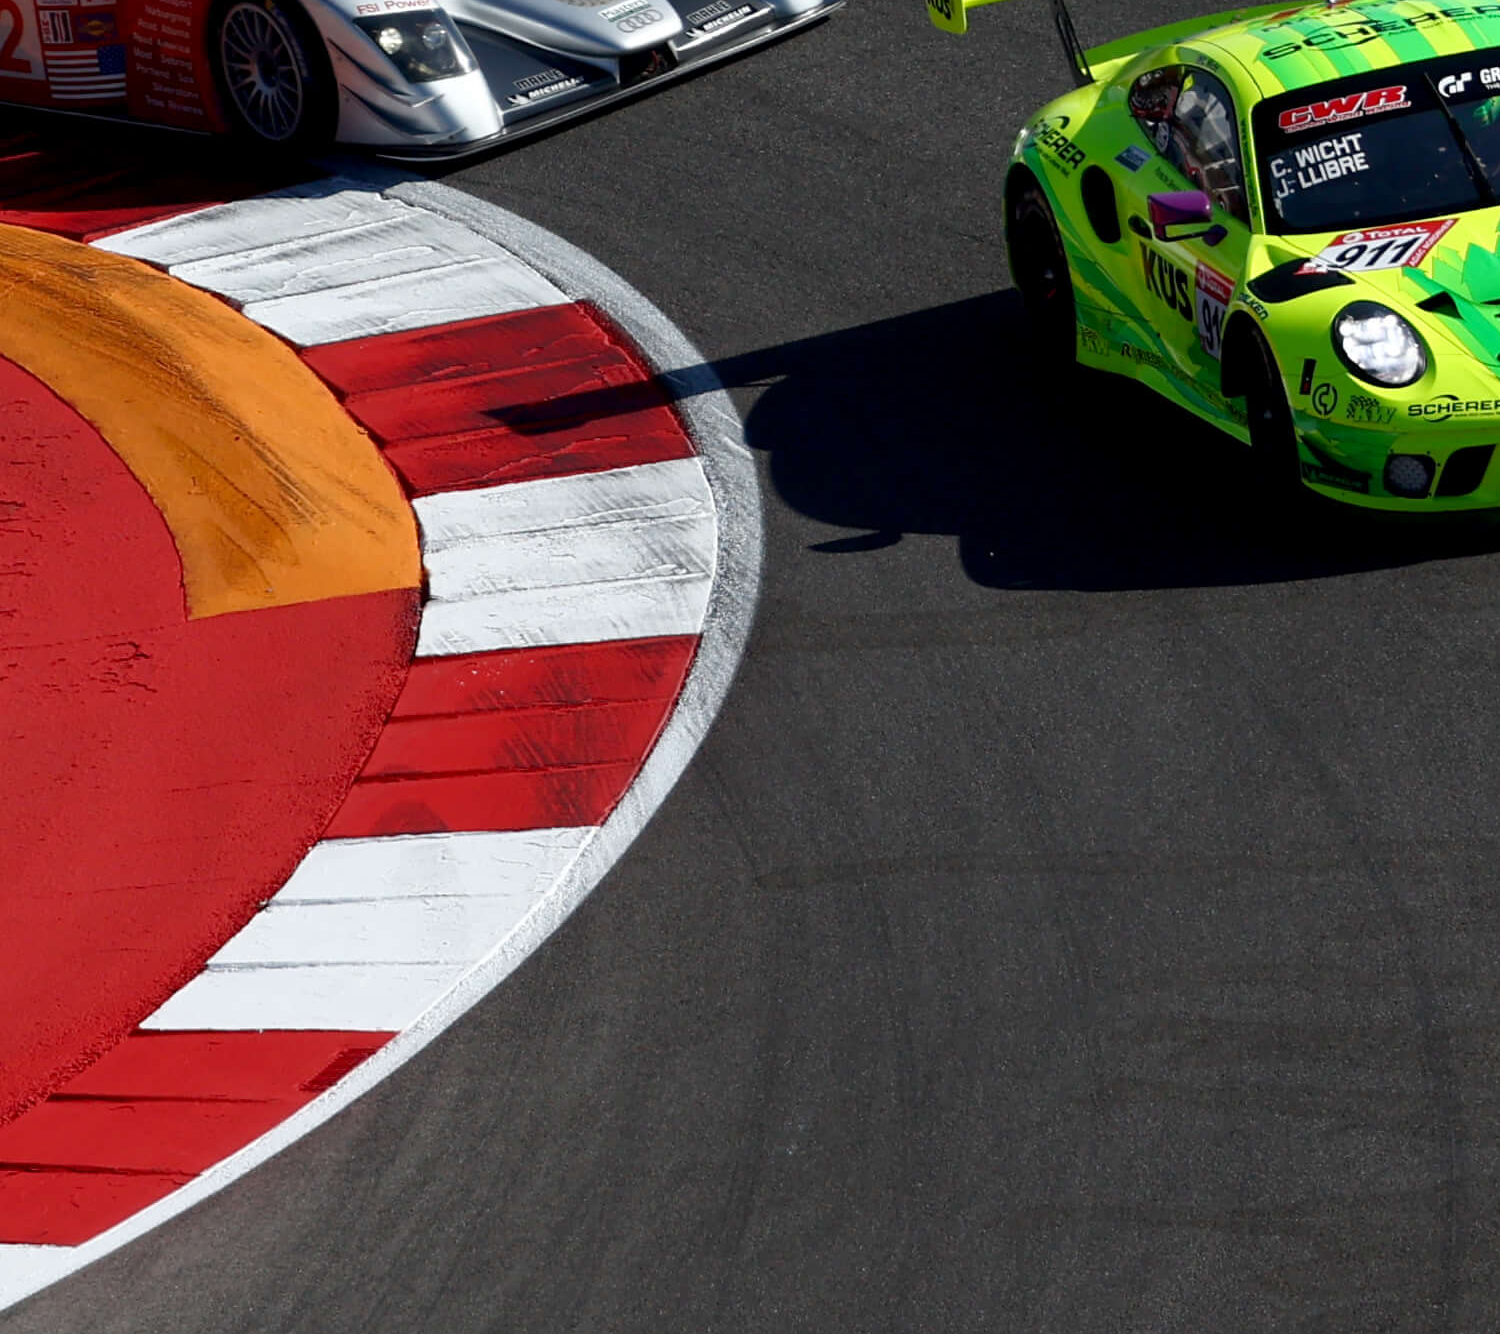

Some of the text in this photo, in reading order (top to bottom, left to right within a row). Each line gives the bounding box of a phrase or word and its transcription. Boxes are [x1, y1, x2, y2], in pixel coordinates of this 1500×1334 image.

[356, 3, 381, 15] FSI
[689, 0, 731, 24] MAHLE
[702, 5, 752, 31] MICHELIN
[516, 69, 566, 90] MAHLE
[1278, 85, 1408, 129] CWR
[1270, 132, 1363, 179] C. WICHT
[1276, 152, 1370, 199] J. LLIBRE
[1335, 236, 1422, 267] 911
[1202, 297, 1228, 351] 91
